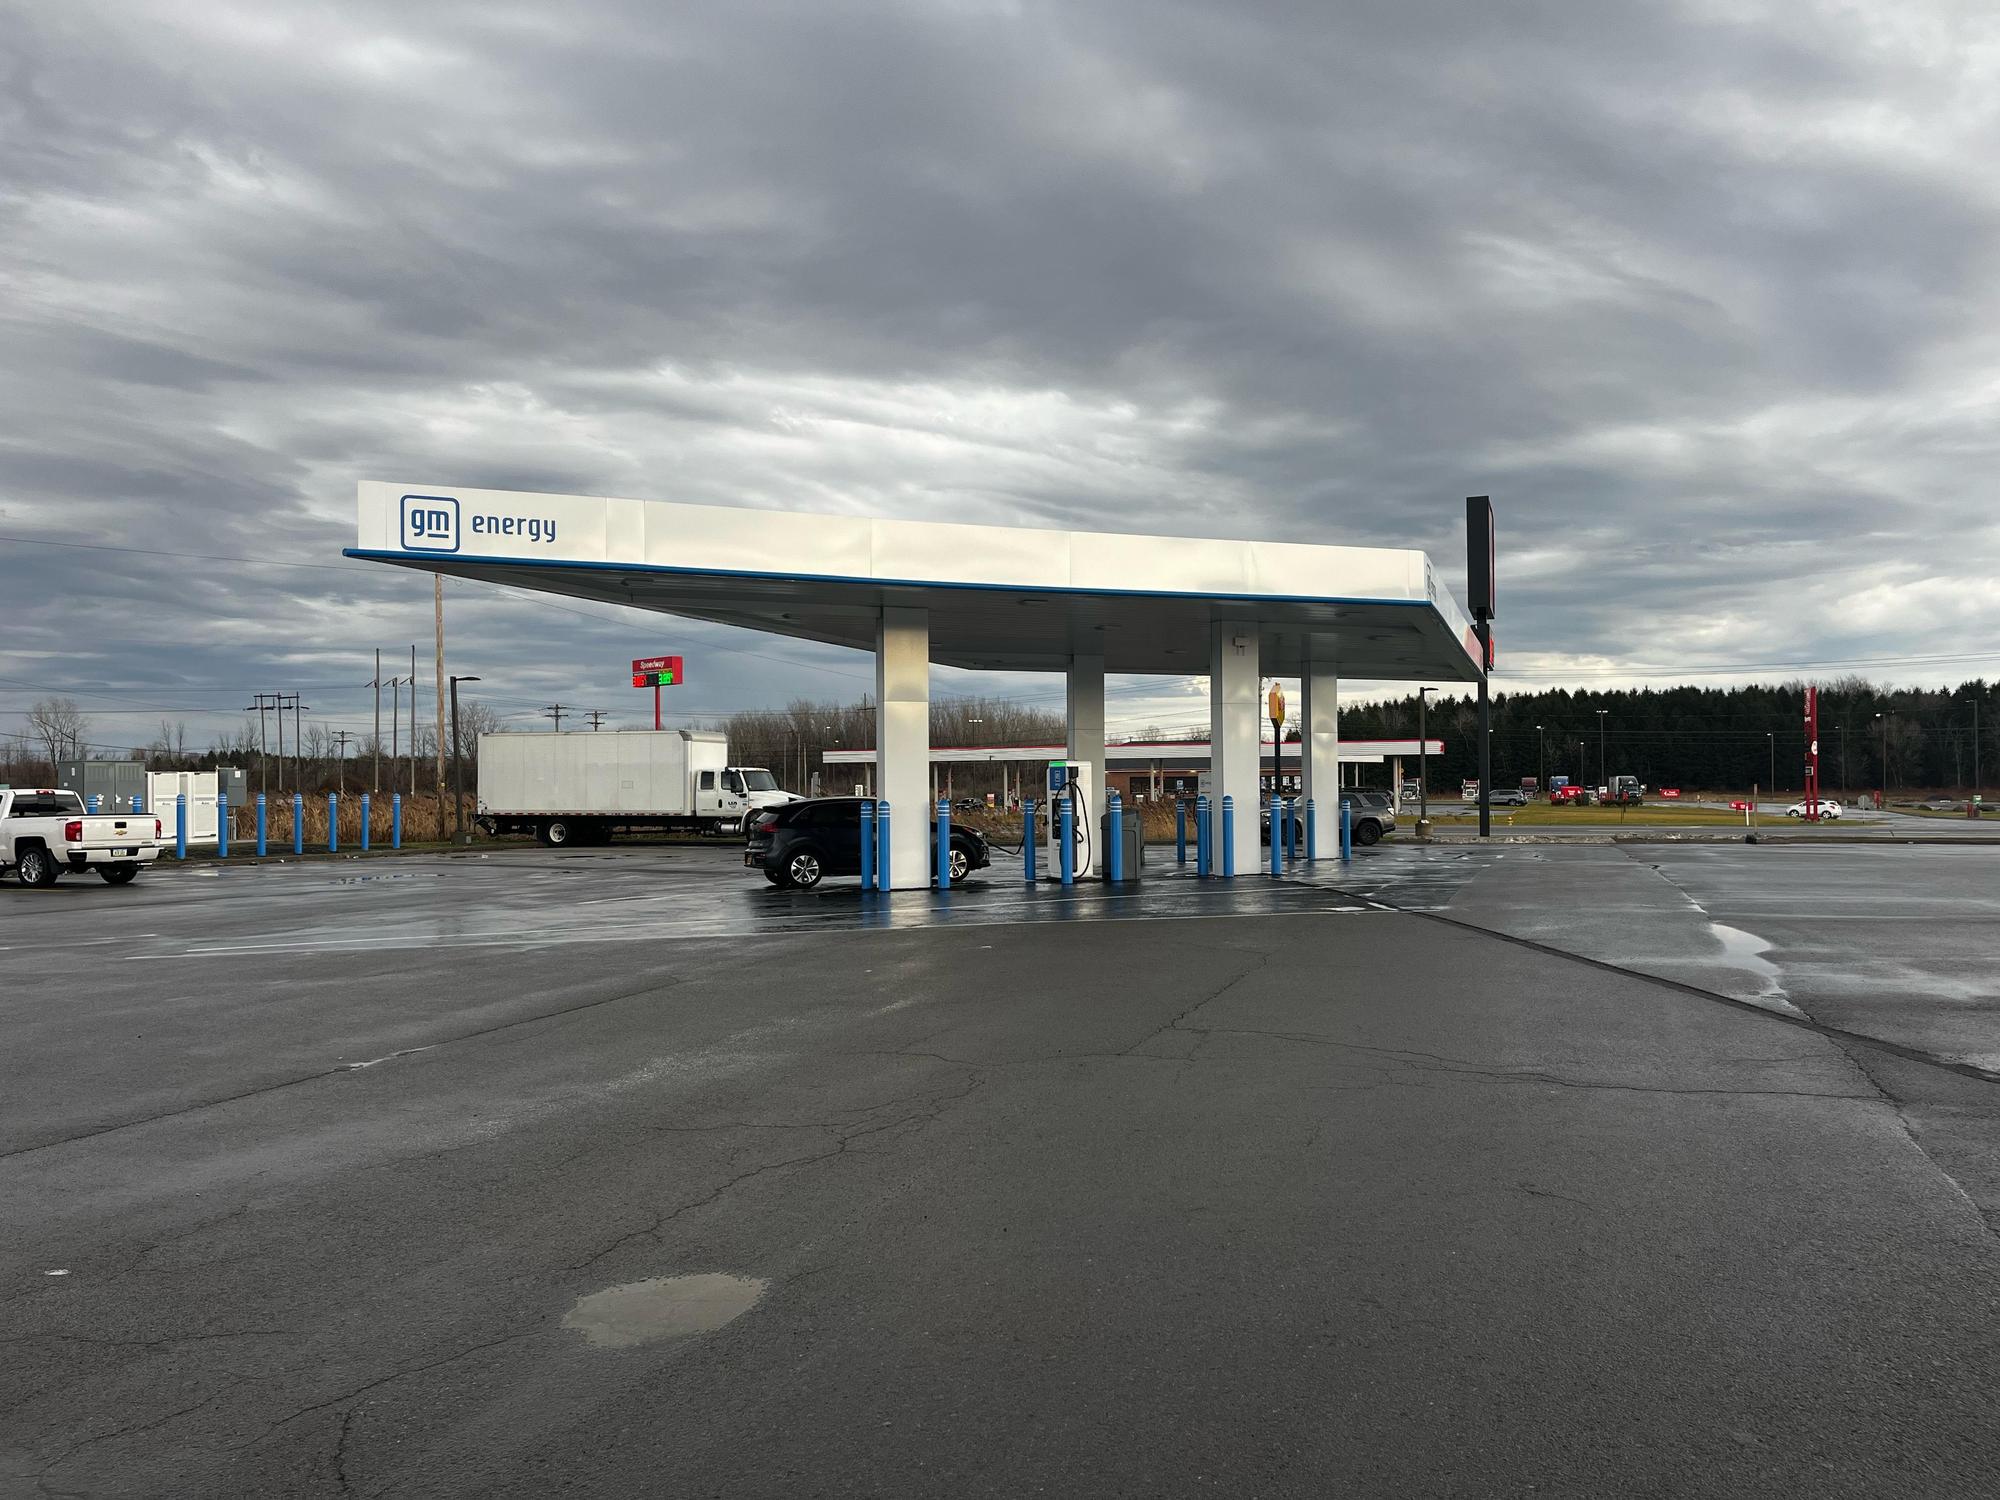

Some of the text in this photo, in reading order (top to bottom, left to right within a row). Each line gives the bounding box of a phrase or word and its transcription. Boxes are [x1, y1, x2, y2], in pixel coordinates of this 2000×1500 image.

[411, 509, 556, 543] gm energy
[640, 660, 665, 670] Speedway
